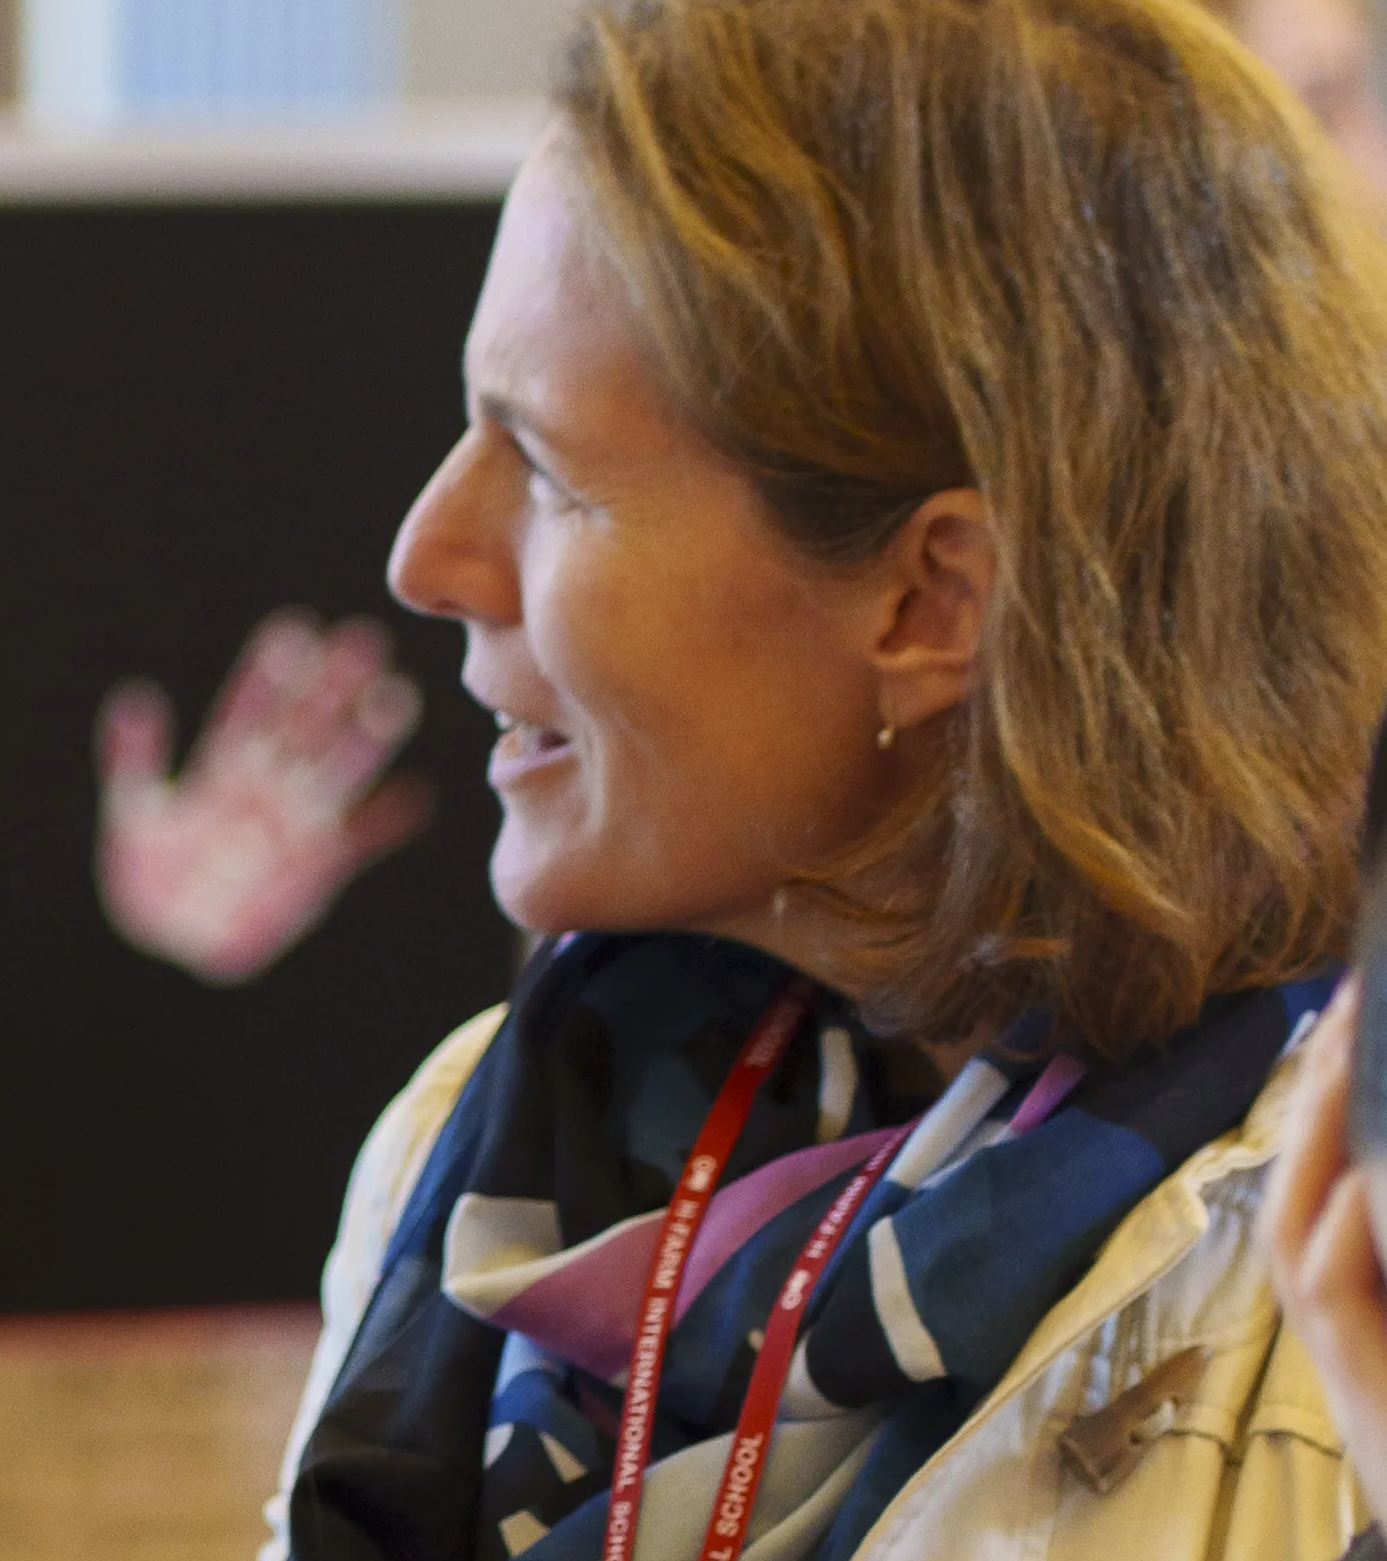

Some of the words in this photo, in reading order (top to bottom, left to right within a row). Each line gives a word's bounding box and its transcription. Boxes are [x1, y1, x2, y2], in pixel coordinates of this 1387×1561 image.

[651, 1198, 700, 1290] H-FARM
[614, 1297, 669, 1494] INTERNATIONAL
[715, 1432, 765, 1538] SCHOOL
